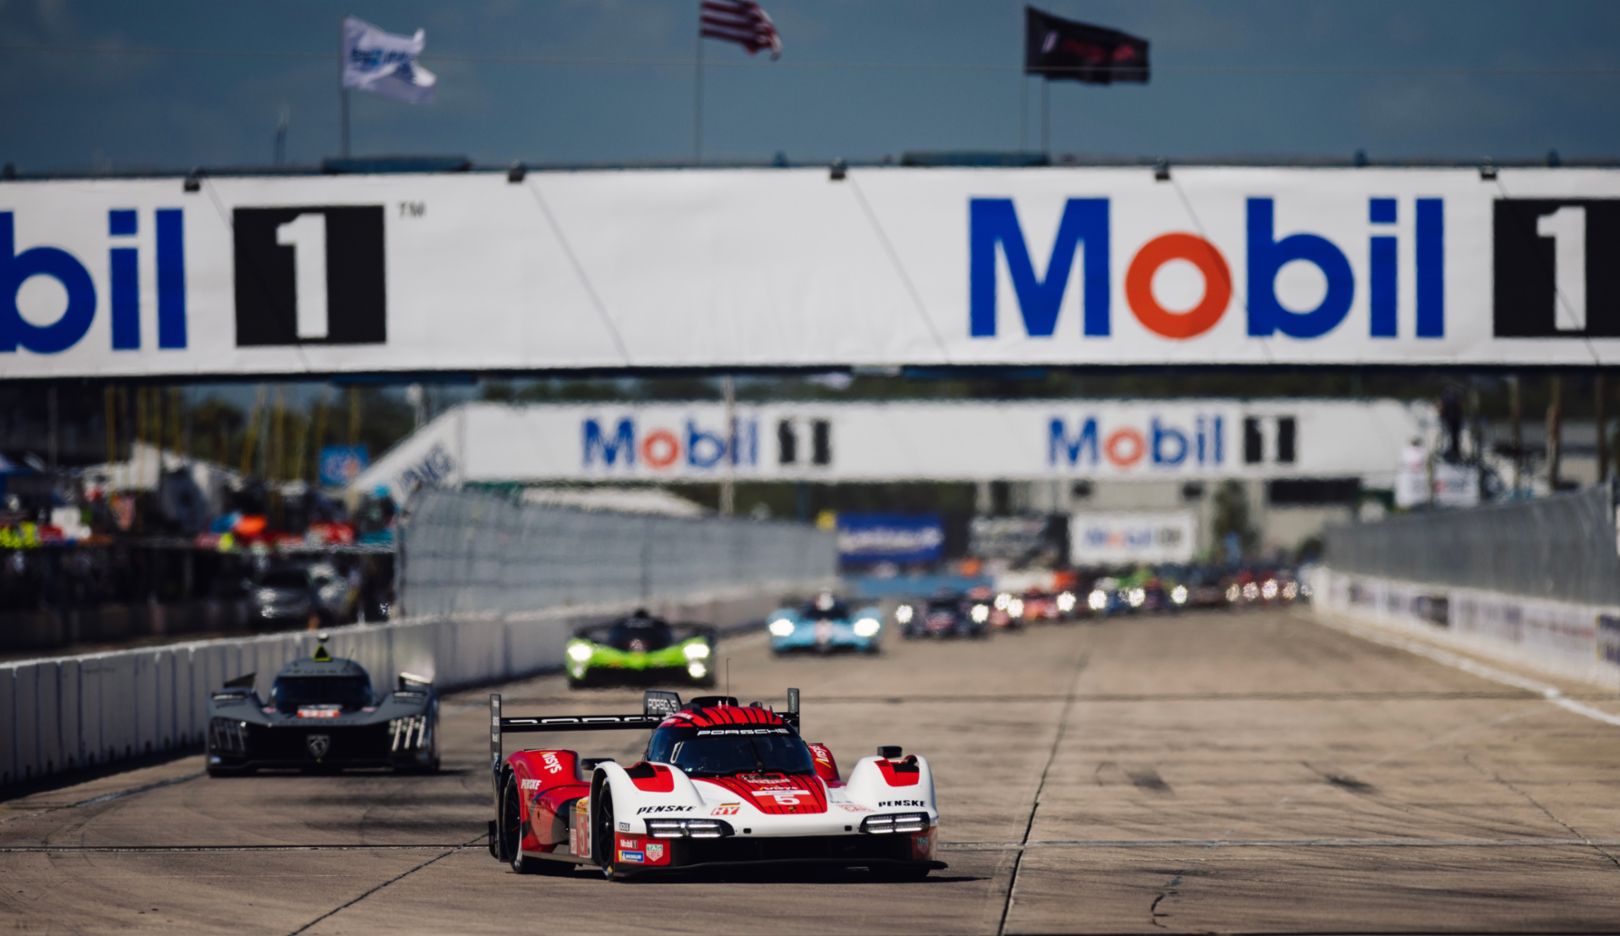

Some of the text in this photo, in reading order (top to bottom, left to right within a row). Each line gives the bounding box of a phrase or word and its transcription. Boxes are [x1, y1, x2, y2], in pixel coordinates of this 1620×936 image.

[276, 213, 329, 339] 1
[400, 202, 425, 217] TM
[968, 196, 1587, 340] Mobil 1
[581, 416, 759, 468] Mobil
[1048, 415, 1224, 468] Mobil
[697, 728, 789, 736] PORSCHE
[637, 805, 696, 815] PENSKE
[773, 794, 800, 805] 5
